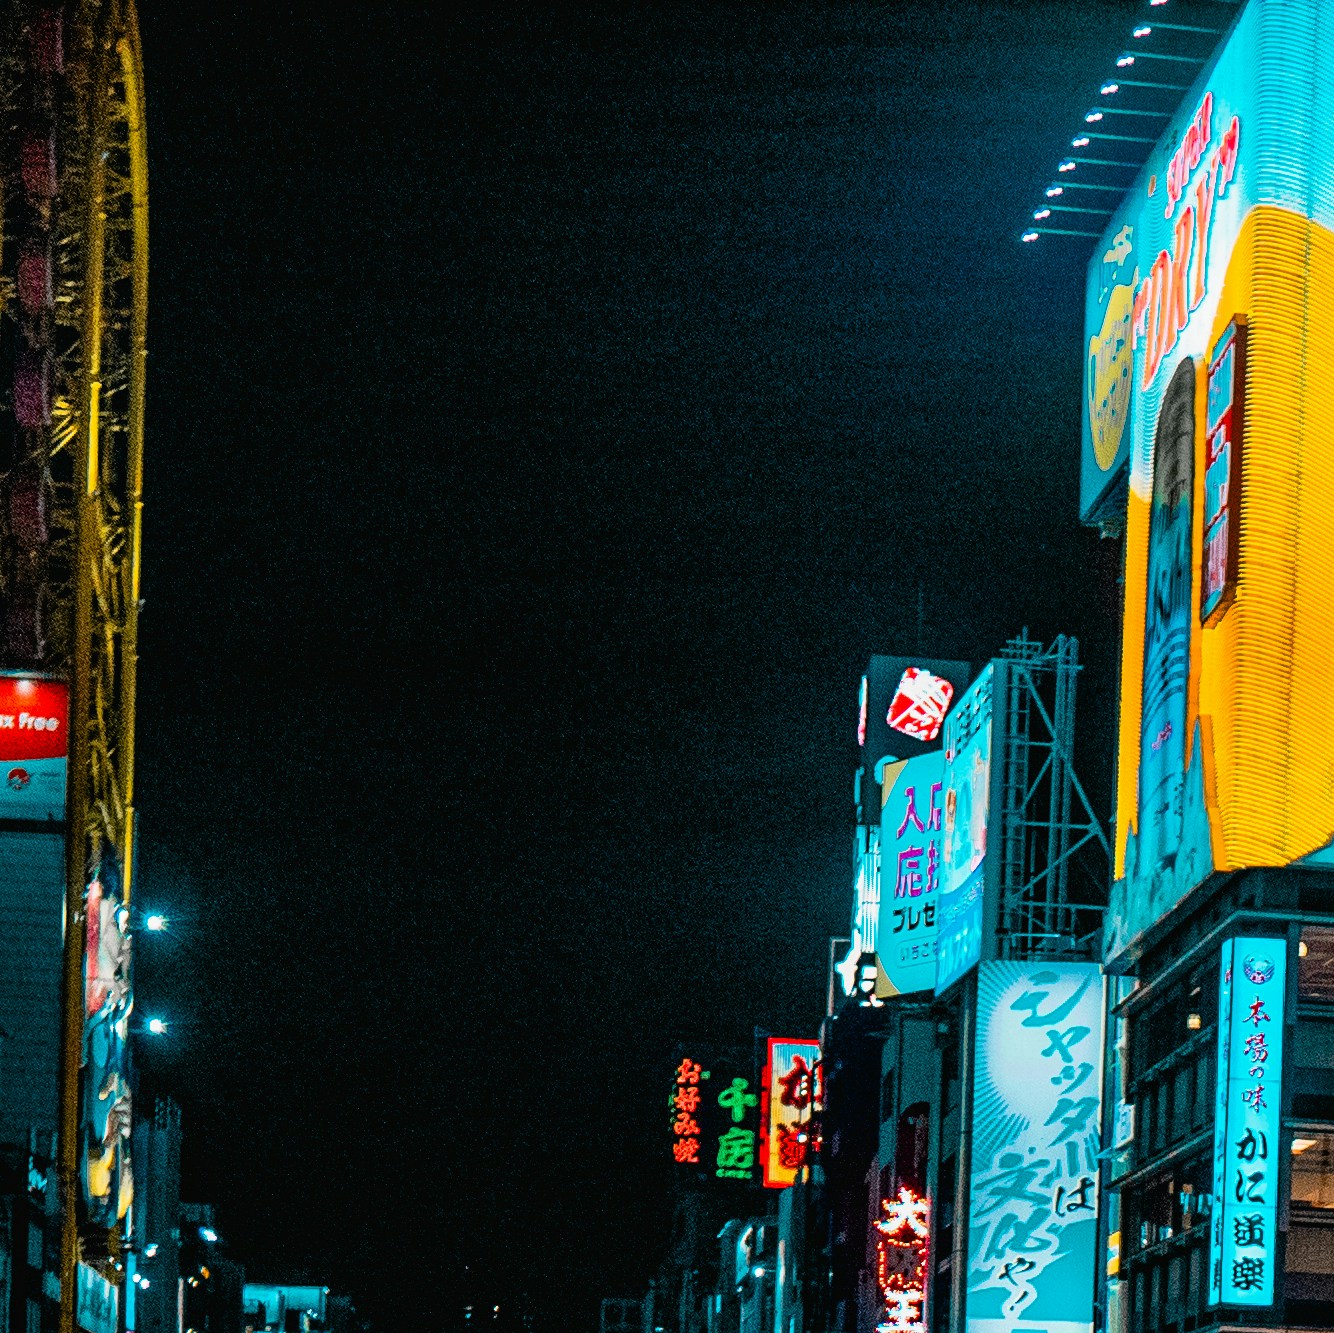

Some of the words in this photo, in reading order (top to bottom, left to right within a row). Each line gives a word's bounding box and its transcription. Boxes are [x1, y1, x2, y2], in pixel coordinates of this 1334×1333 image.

[717, 1078, 758, 1168] 千房
[1233, 1127, 1269, 1291] かに道楽
